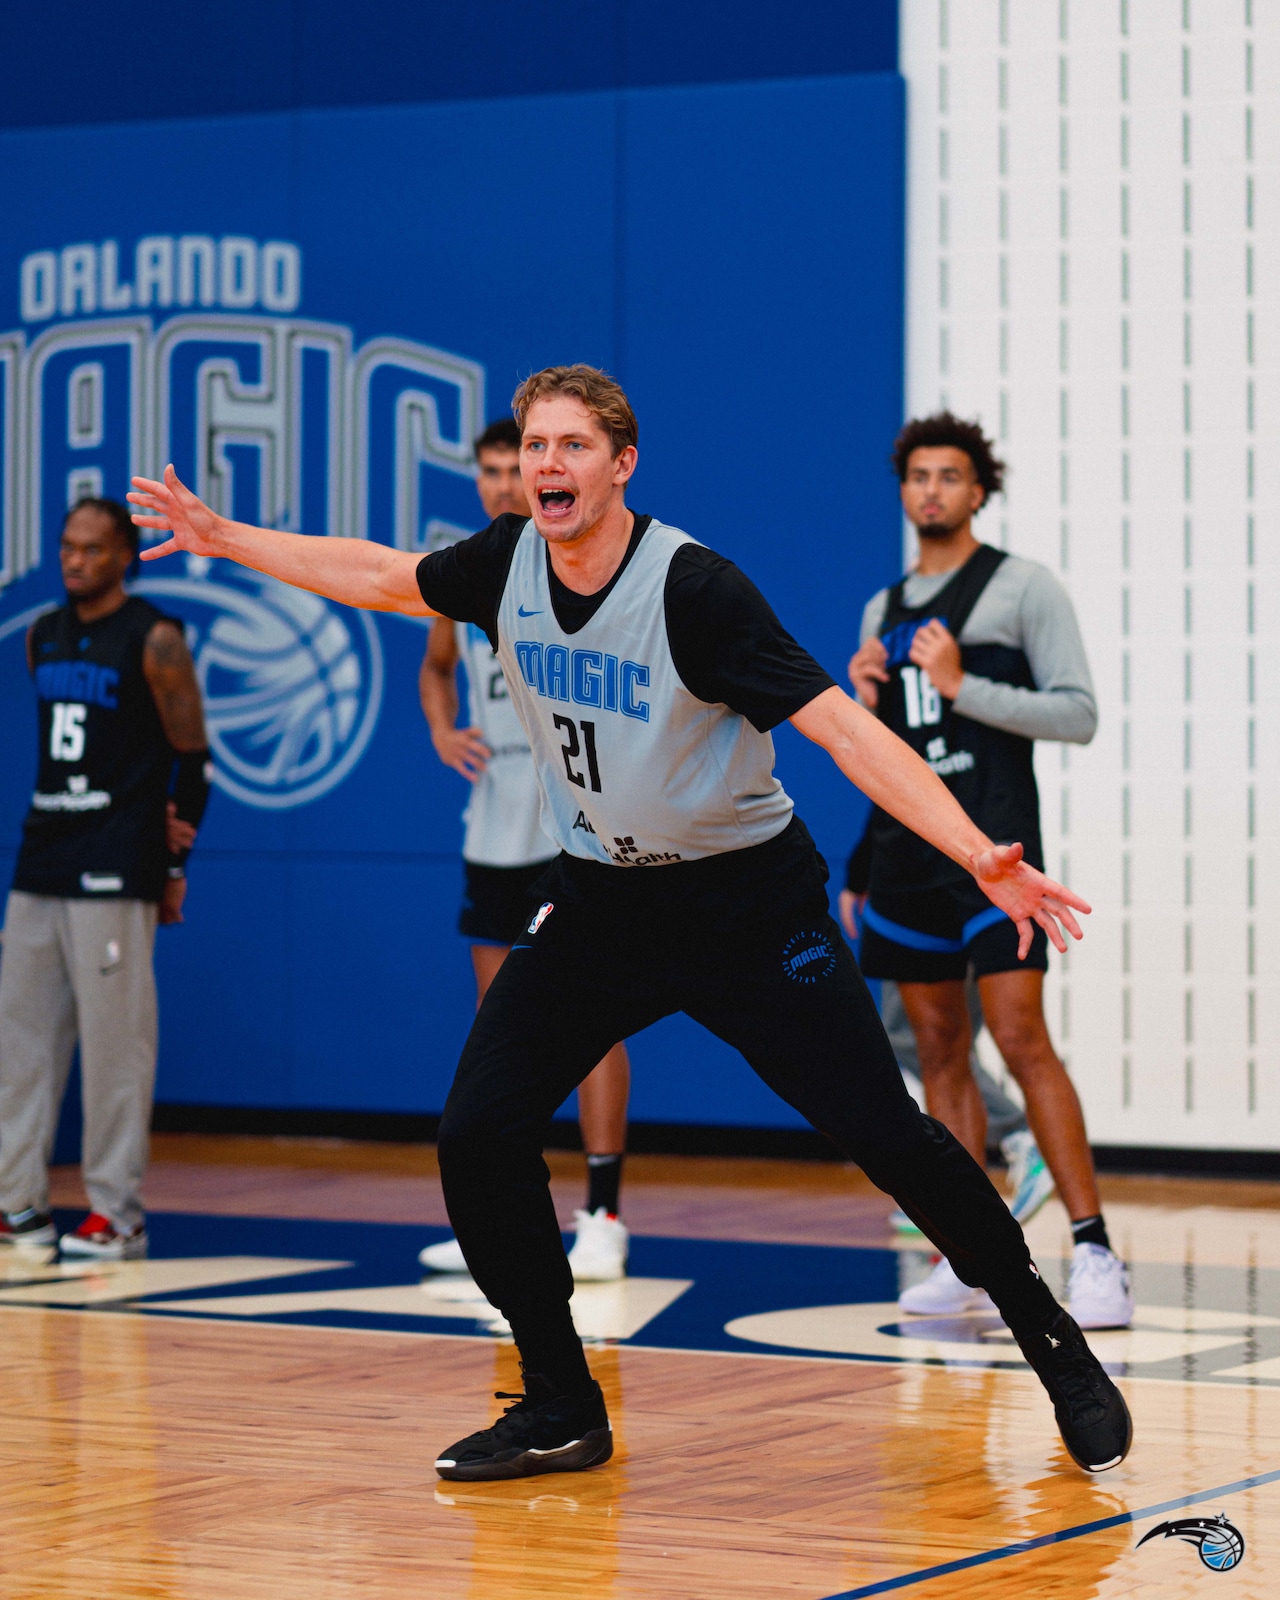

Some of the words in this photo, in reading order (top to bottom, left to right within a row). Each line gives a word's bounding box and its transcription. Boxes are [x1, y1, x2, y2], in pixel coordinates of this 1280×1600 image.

[20, 235, 301, 320] ORLANDO
[0, 313, 486, 590] AGIC
[514, 641, 650, 723] MAGIC
[51, 702, 87, 762] 15
[552, 712, 602, 794] 21
[790, 945, 830, 971] MAGIC
